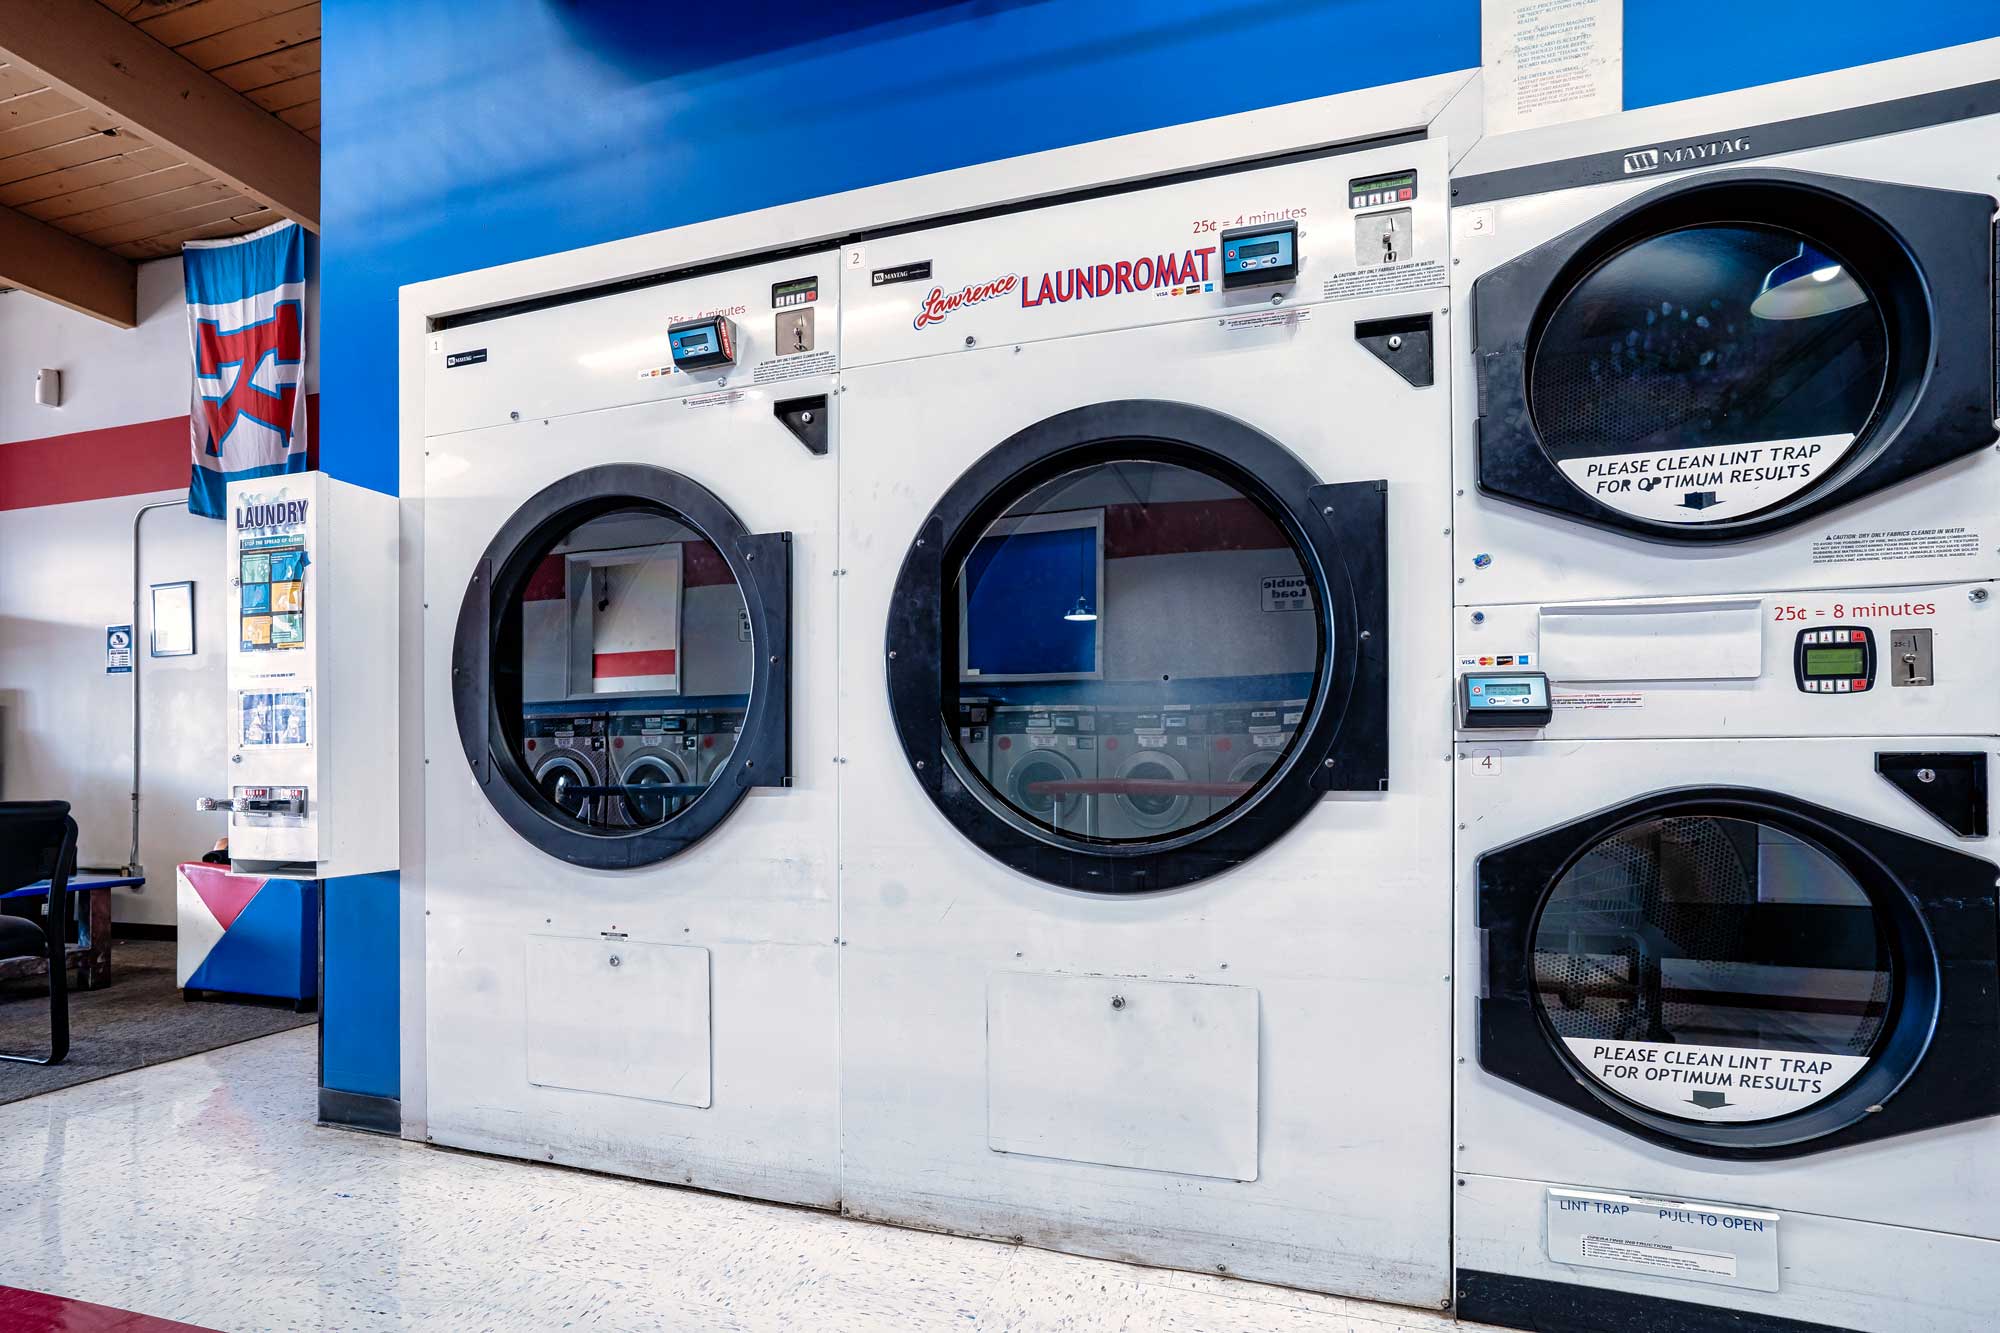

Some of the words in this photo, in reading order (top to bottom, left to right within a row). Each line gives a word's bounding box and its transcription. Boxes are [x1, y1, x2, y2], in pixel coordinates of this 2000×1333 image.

[1663, 136, 1750, 164] MAYTAG
[1193, 220, 1217, 234] 25¢
[1235, 216, 1244, 226] 4
[1249, 208, 1308, 225] minutes
[1474, 216, 1483, 230] 3
[852, 252, 860, 264] 2
[884, 270, 908, 280] MAYTAG
[914, 273, 1020, 330] Lawrence
[1021, 246, 1216, 308] LAUNDROMAT
[434, 341, 438, 350] 1
[1587, 460, 1650, 477] PLEASE
[1656, 454, 1715, 472] CLEAN
[1720, 450, 1762, 466] LINT
[1770, 444, 1822, 462] TRAP
[1596, 479, 1632, 494] FOR
[1638, 472, 1724, 492] OPTIMUM
[1730, 464, 1811, 482] RESULTS
[236, 500, 308, 530] LAUNDRY
[1774, 607, 1808, 621] 25¢
[1833, 604, 1844, 618] 8
[1852, 602, 1936, 618] minutes
[1481, 755, 1492, 769] 4
[1594, 1046, 1658, 1063] PLEASE
[1664, 1050, 1723, 1068] CLEAN
[1728, 1055, 1772, 1071] LINT
[1780, 1058, 1832, 1076] TRAP
[1602, 1065, 1638, 1080] FOR
[1645, 1067, 1732, 1087] OPTIMUM
[1739, 1074, 1822, 1094] RESULTS
[1560, 1200, 1590, 1212] LINT
[1594, 1202, 1630, 1216] TRAP
[1659, 1209, 1694, 1224] PULL
[1698, 1213, 1718, 1227] TO
[1722, 1217, 1764, 1232] OPEN
